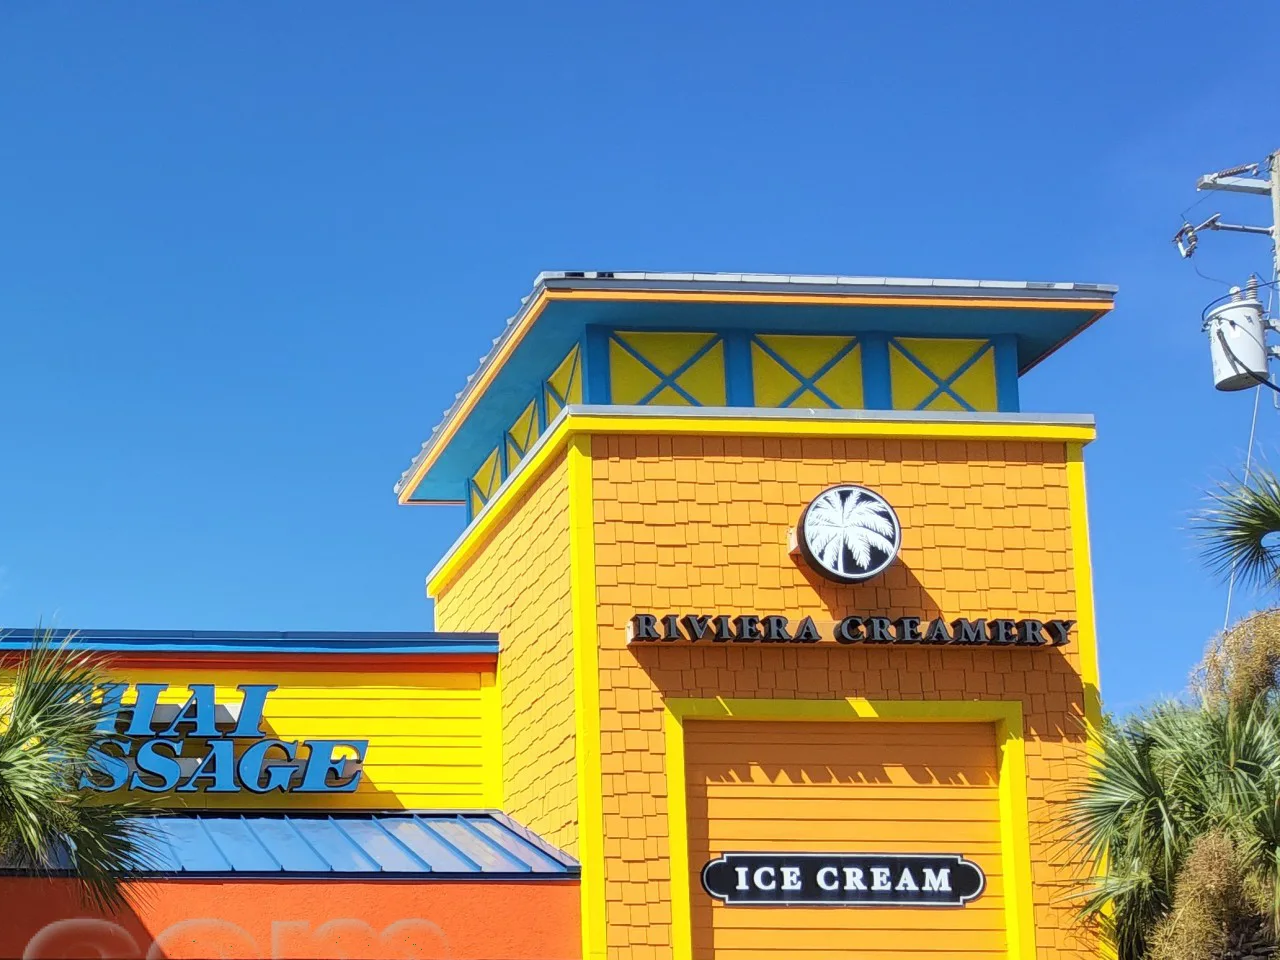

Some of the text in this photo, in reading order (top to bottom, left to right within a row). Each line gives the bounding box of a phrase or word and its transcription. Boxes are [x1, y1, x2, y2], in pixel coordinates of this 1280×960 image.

[631, 613, 1077, 645] RIVIERA CREAMERY
[48, 738, 370, 793] SSAGE
[735, 867, 953, 892] ICE CREAM
